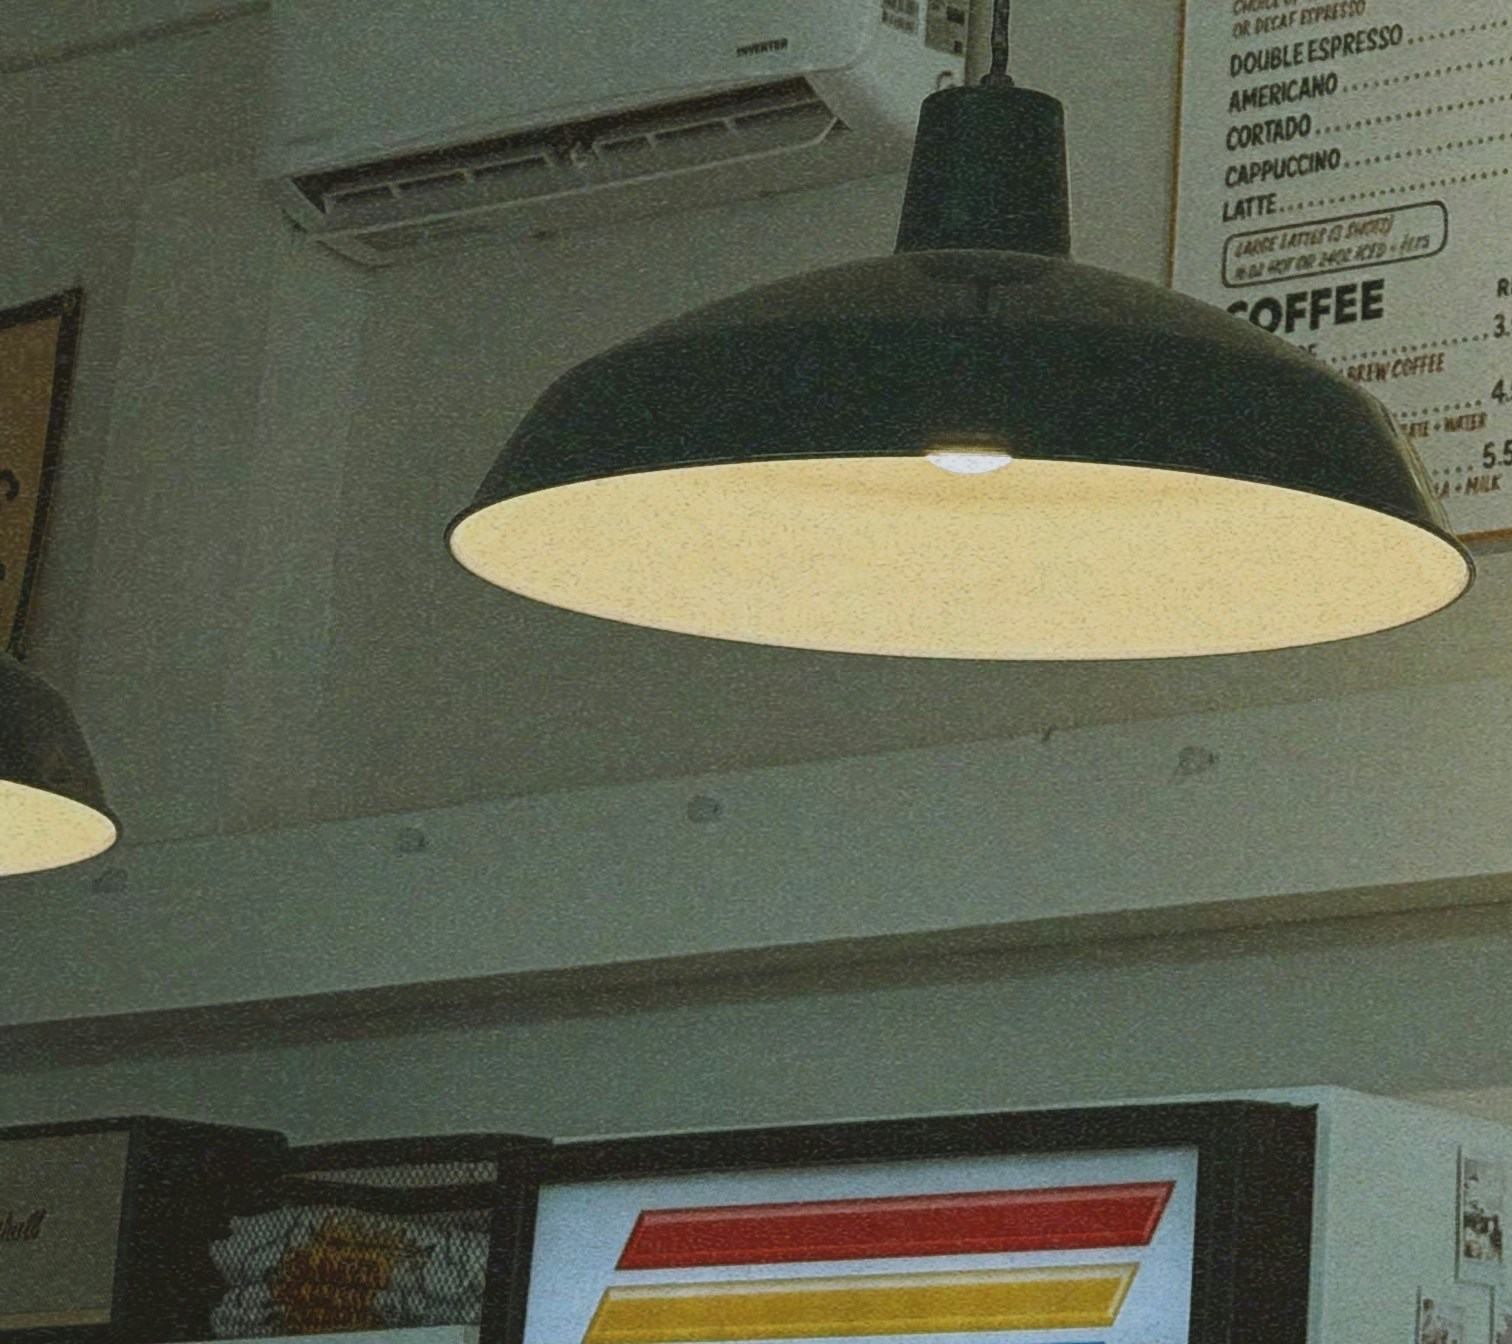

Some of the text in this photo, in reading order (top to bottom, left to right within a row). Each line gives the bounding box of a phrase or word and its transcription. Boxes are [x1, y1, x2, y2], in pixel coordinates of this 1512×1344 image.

[1232, 0, 1366, 38] OR DECAF ESPRESSO
[1230, 42, 1303, 78] DOUBLE
[1307, 23, 1403, 63] ESPRESSO
[1227, 72, 1338, 113] AMERICANO
[1226, 113, 1311, 152] CORTADO
[1224, 148, 1341, 189] CAPPUCCINO
[1222, 193, 1277, 224] LATTE
[1391, 352, 1445, 379] COFFEE
